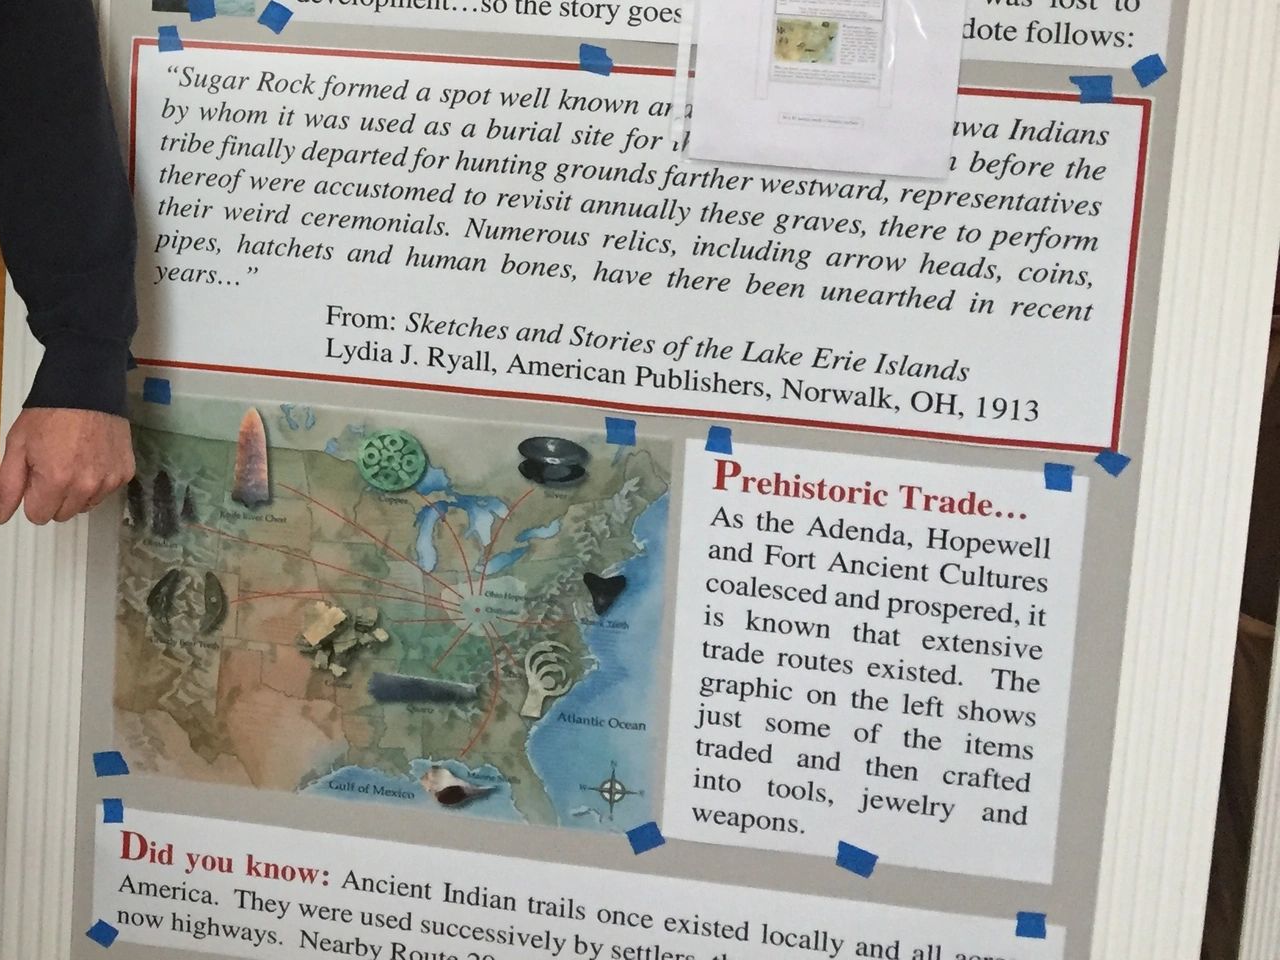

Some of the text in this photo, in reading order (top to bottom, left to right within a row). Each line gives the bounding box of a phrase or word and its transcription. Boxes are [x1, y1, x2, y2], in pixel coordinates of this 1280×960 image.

[160, 132, 1102, 216] tribe finally departed for hunting grounds farther westward, representatives
[326, 305, 970, 382] From: Sketches and Stories of the Lake Erie Islands
[326, 338, 1038, 422] Lydia J. Ryall, American Publishers, Norwalk, OH, 1913
[713, 457, 1026, 521] Prehistoric Trade...
[710, 506, 1050, 562] As the Adenda, Hopewell
[708, 542, 1048, 594] and Fort Ancient Cultures
[557, 712, 647, 731] Atlantic Ocean
[328, 779, 415, 800] Gulf of Mexico
[694, 768, 1027, 825] into tools, jewelry and
[692, 806, 805, 834] weapons.
[120, 830, 940, 960] Did you know: Ancient Indian trails once existed locally and all
